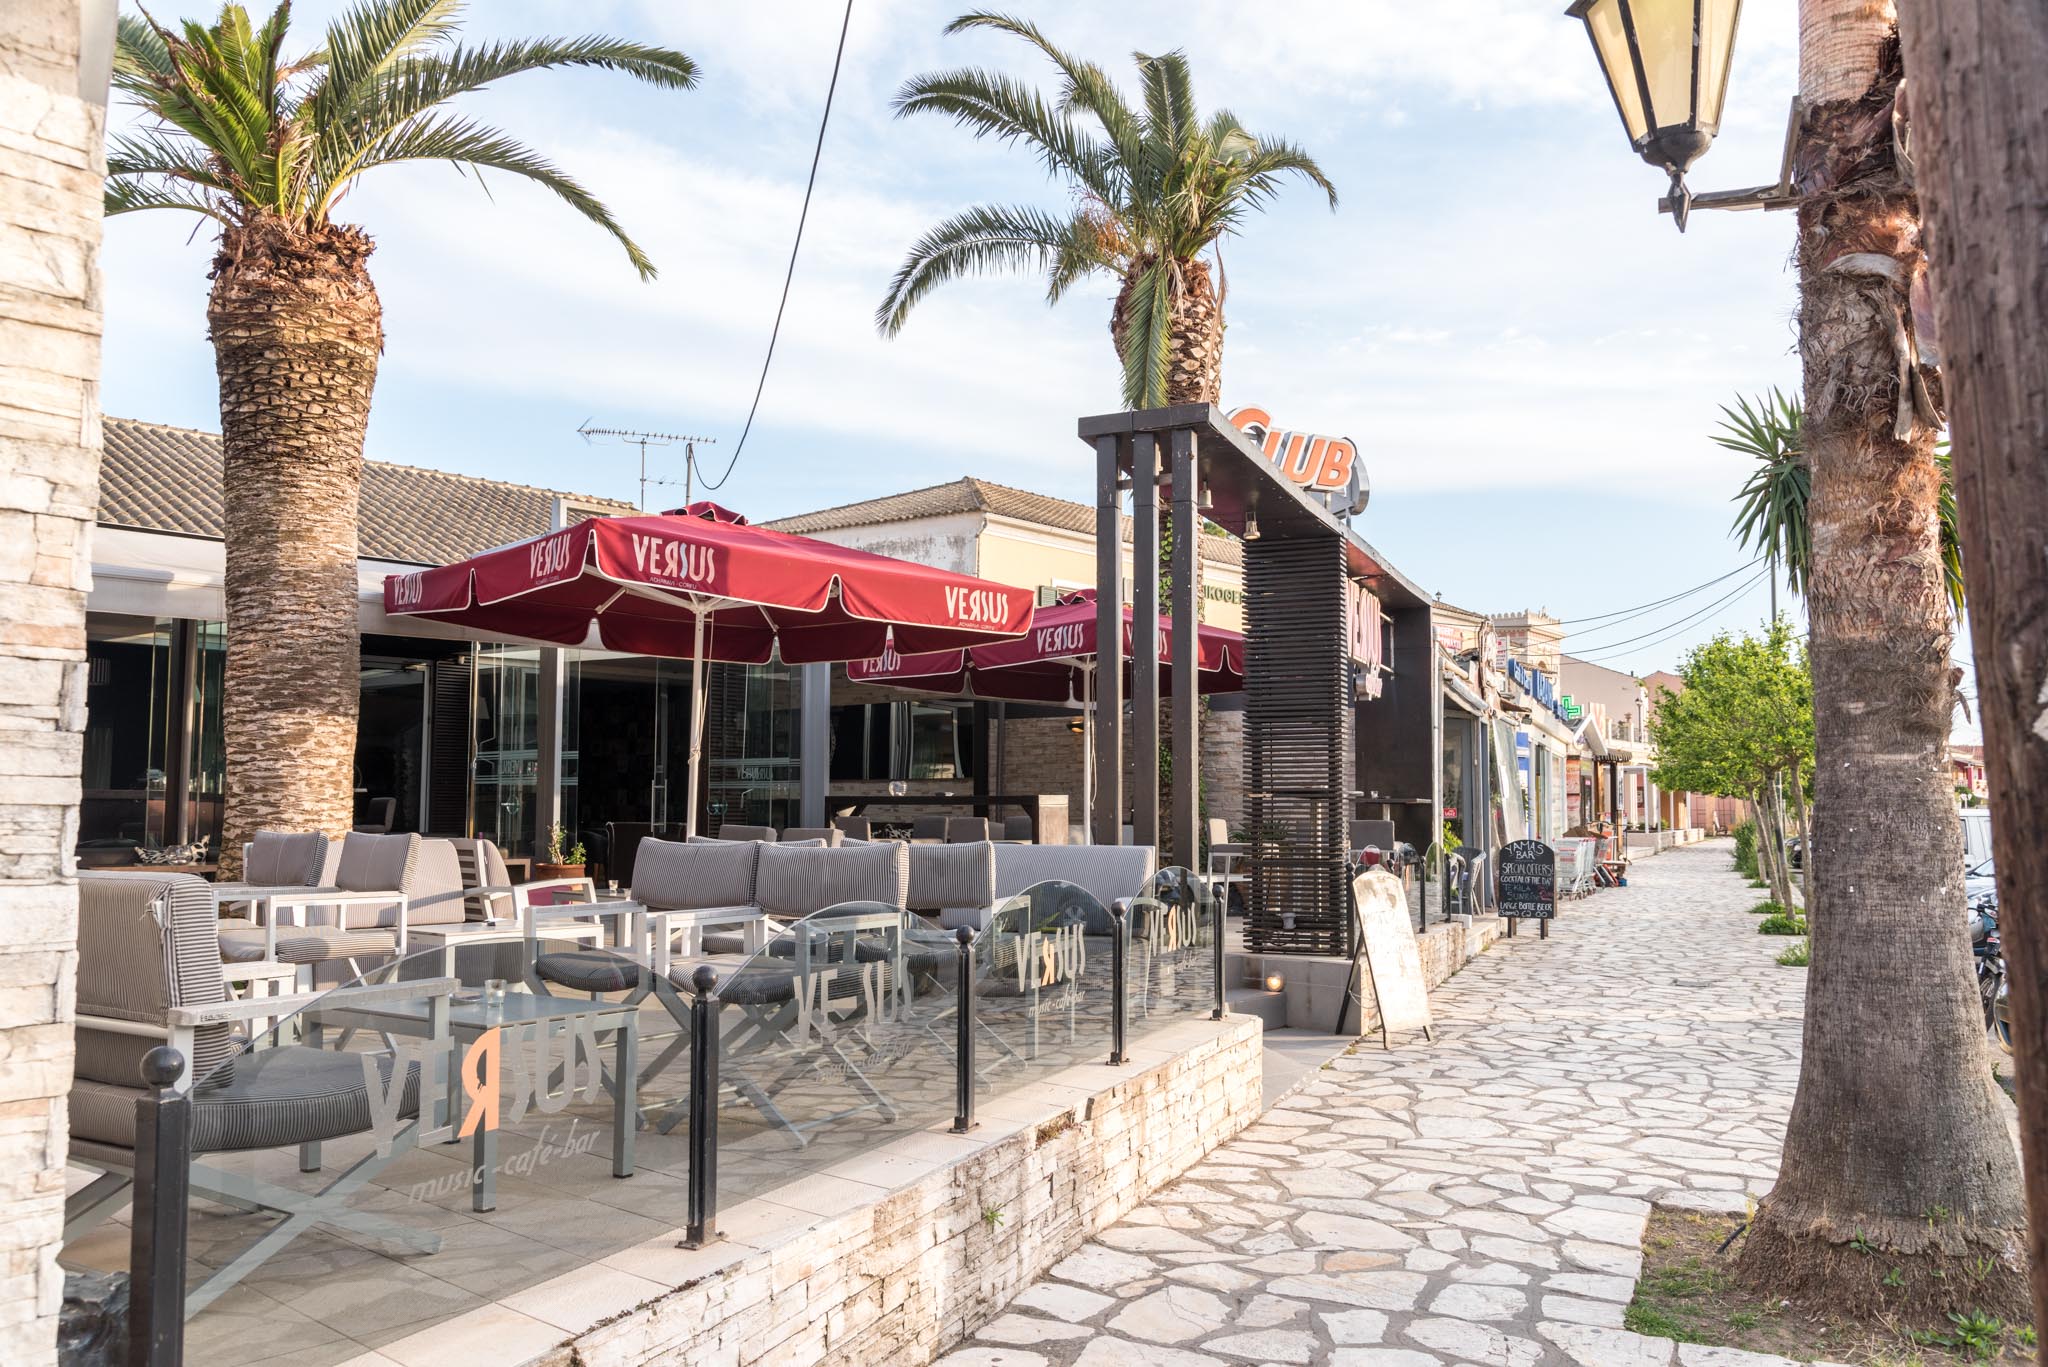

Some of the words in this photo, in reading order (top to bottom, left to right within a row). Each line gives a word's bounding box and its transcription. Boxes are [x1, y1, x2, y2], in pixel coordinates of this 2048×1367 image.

[530, 533, 571, 579] VERSUS
[632, 533, 715, 584] VERSUS
[945, 585, 1009, 624] VERSUS
[1037, 623, 1084, 653] VERSUS
[1505, 841, 1544, 854] YAMAS
[1516, 850, 1535, 859] BAR
[1015, 923, 1086, 992] VERSUS
[361, 1011, 598, 1160] VERSUS
